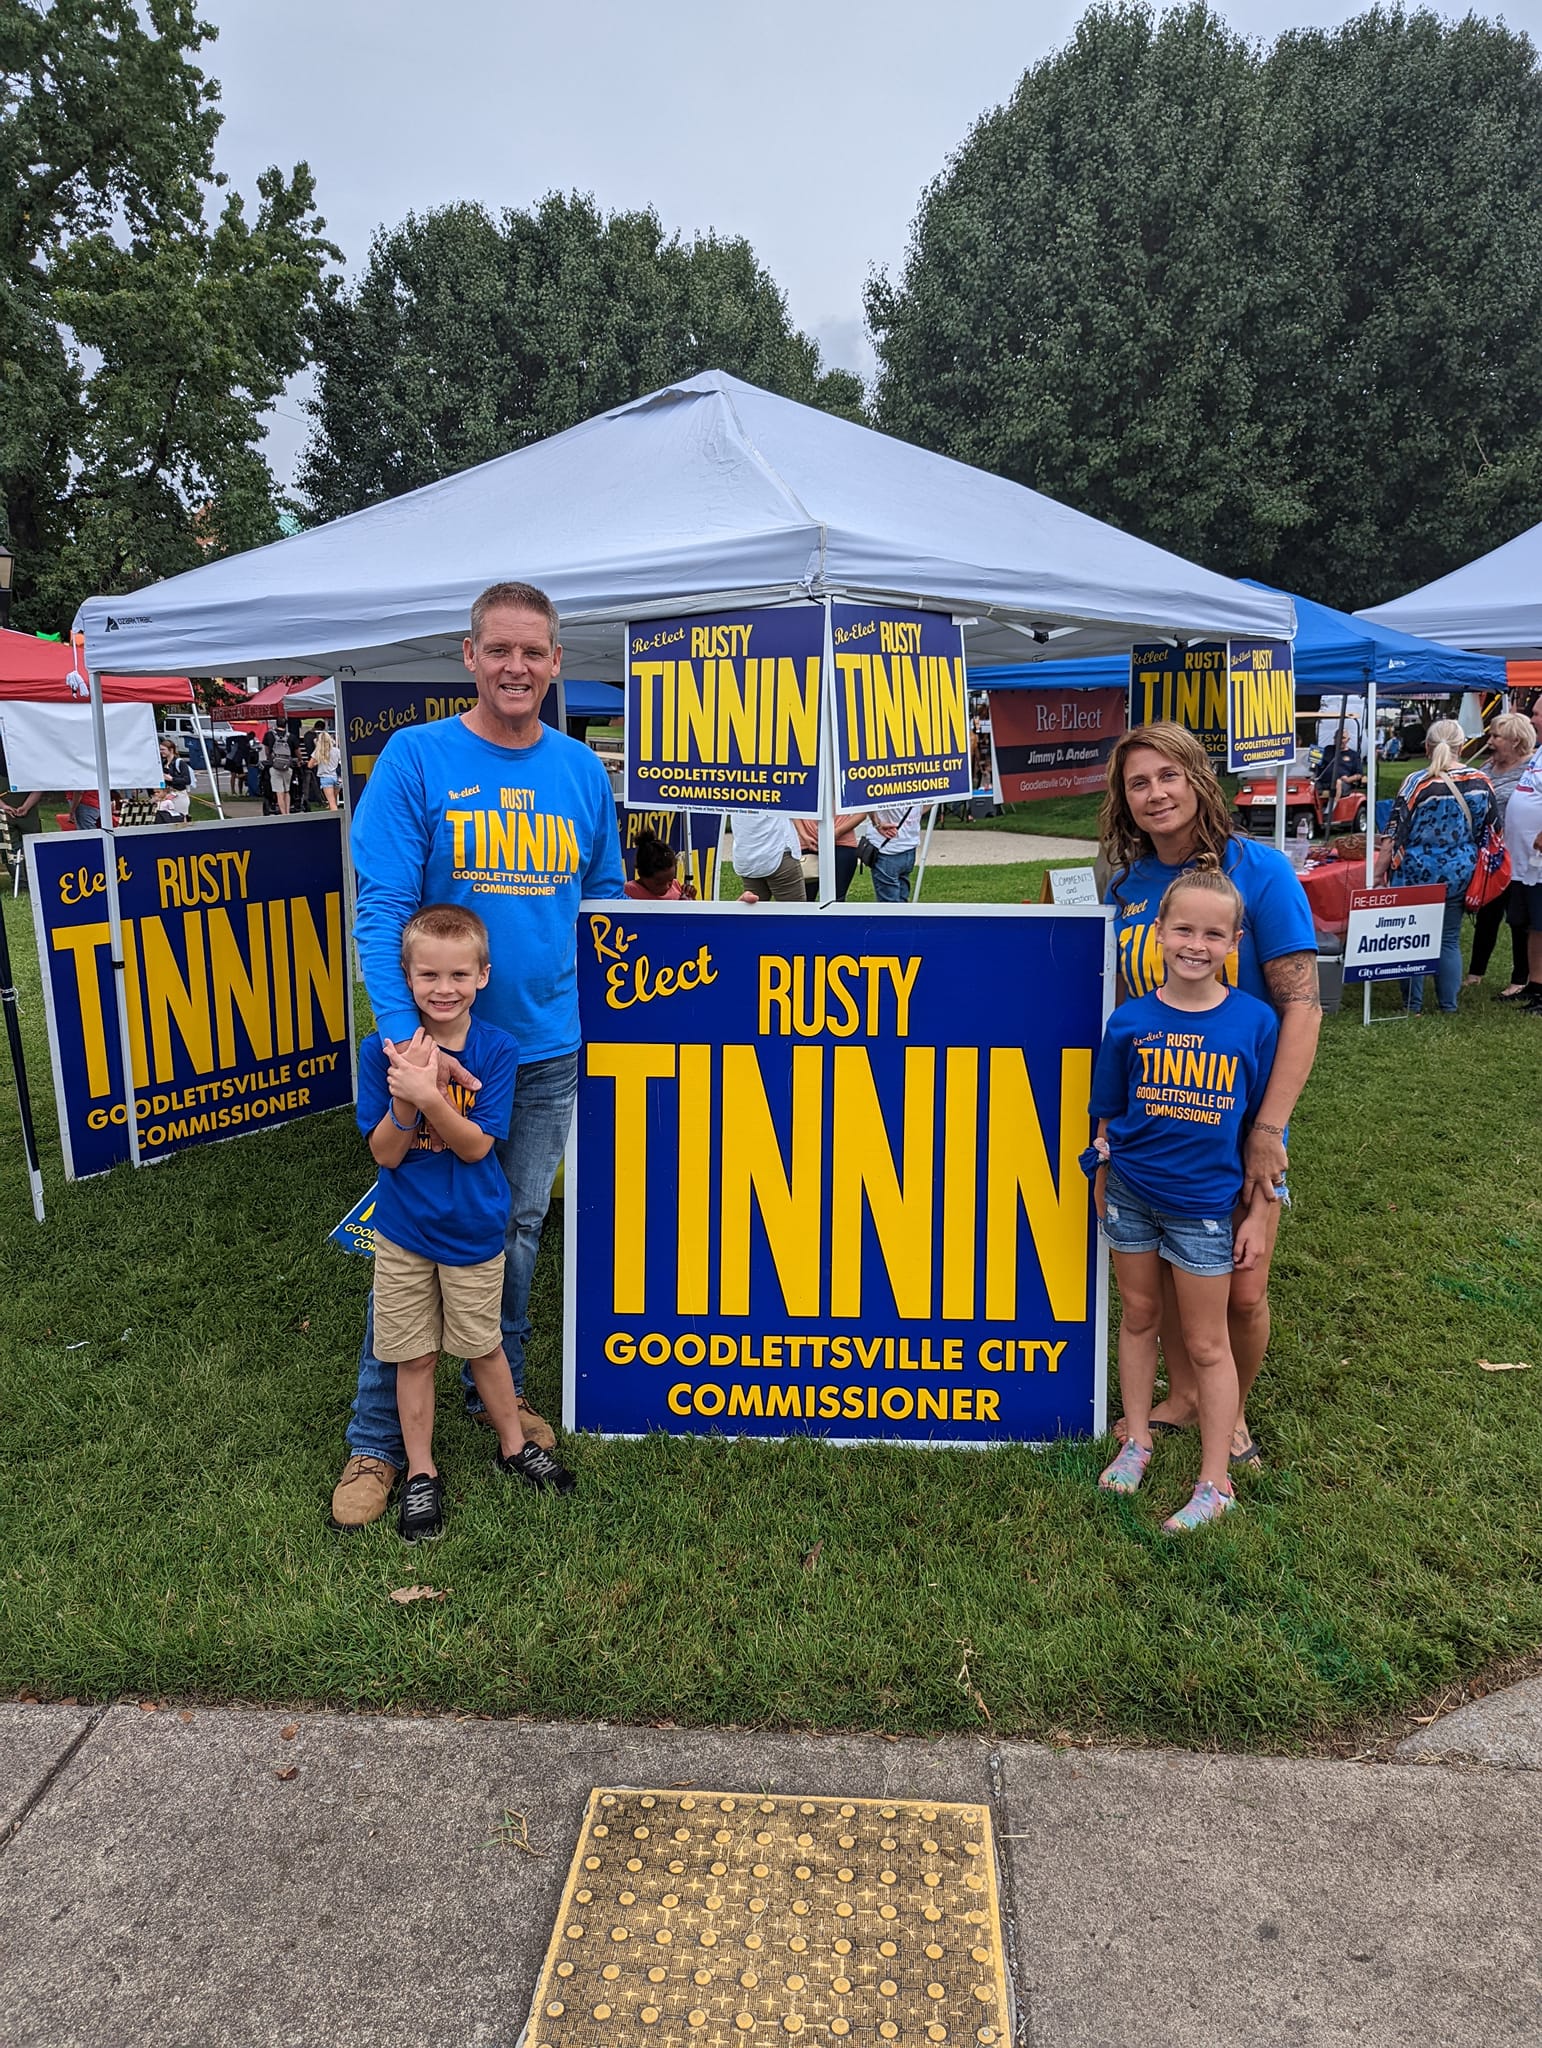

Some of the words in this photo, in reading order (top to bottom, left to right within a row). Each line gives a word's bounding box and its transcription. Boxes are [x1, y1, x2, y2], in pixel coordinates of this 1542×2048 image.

[631, 627, 685, 654] Re-Elect
[691, 624, 753, 658] RUSTY
[834, 620, 876, 645] Re-Elect
[879, 621, 922, 654] RUSTY
[1252, 649, 1273, 670] RUSTY
[631, 656, 820, 766] TINNIN
[835, 653, 967, 761] TINNIN
[1139, 671, 1227, 730] TINN
[1230, 670, 1293, 739] TINNIN
[350, 703, 417, 742] Re-Elect
[1035, 703, 1102, 731] Re-Elect
[1234, 738, 1281, 751] GOODLETTSVILLE
[1281, 736, 1292, 745] CITY
[1243, 749, 1285, 762] COMMISSIONER
[848, 762, 940, 781] GOODLETTSVILLE
[943, 758, 963, 772] CITY
[1027, 750, 1056, 765] Jimmy
[1056, 749, 1065, 761] D.
[637, 766, 767, 784] GOODLETTSVILLE
[772, 771, 808, 785] CITY
[866, 777, 950, 797] COMMISSIONER
[448, 784, 480, 800] Re-elect
[500, 787, 535, 810] RUSTY
[659, 785, 781, 803] COMMISSIONER
[446, 810, 579, 873] TINNIN
[59, 856, 133, 904] Elet
[157, 850, 250, 908] RUSTY
[452, 871, 549, 884] GOODLETTSVILLE
[473, 883, 556, 895] COMMISSIONER
[1354, 894, 1398, 907] RE-ELECT
[1375, 917, 1406, 928] Jimmy
[1408, 914, 1417, 925] D.
[1357, 933, 1430, 953] Anderson
[1358, 968, 1373, 978] City
[1374, 964, 1427, 976] Commissioner
[52, 892, 346, 1098] TINNIN
[605, 945, 718, 1010] Elect
[759, 955, 922, 1037] RUSTY
[1166, 1033, 1204, 1049] RUSTY
[1137, 1048, 1238, 1092] TINNIN
[87, 1065, 291, 1130] GOODLETTSVILLE
[297, 1052, 338, 1079] CITY
[1136, 1086, 1215, 1108] GOODLETTSVILLE
[1216, 1095, 1235, 1110] CITY
[1145, 1103, 1221, 1125] COMMISSIONER
[586, 1043, 1092, 1322] TINNIN
[604, 1332, 963, 1371] GOODLETTSVILLE
[978, 1339, 1068, 1373] CITY
[667, 1382, 1001, 1422] COMMISSIONER
